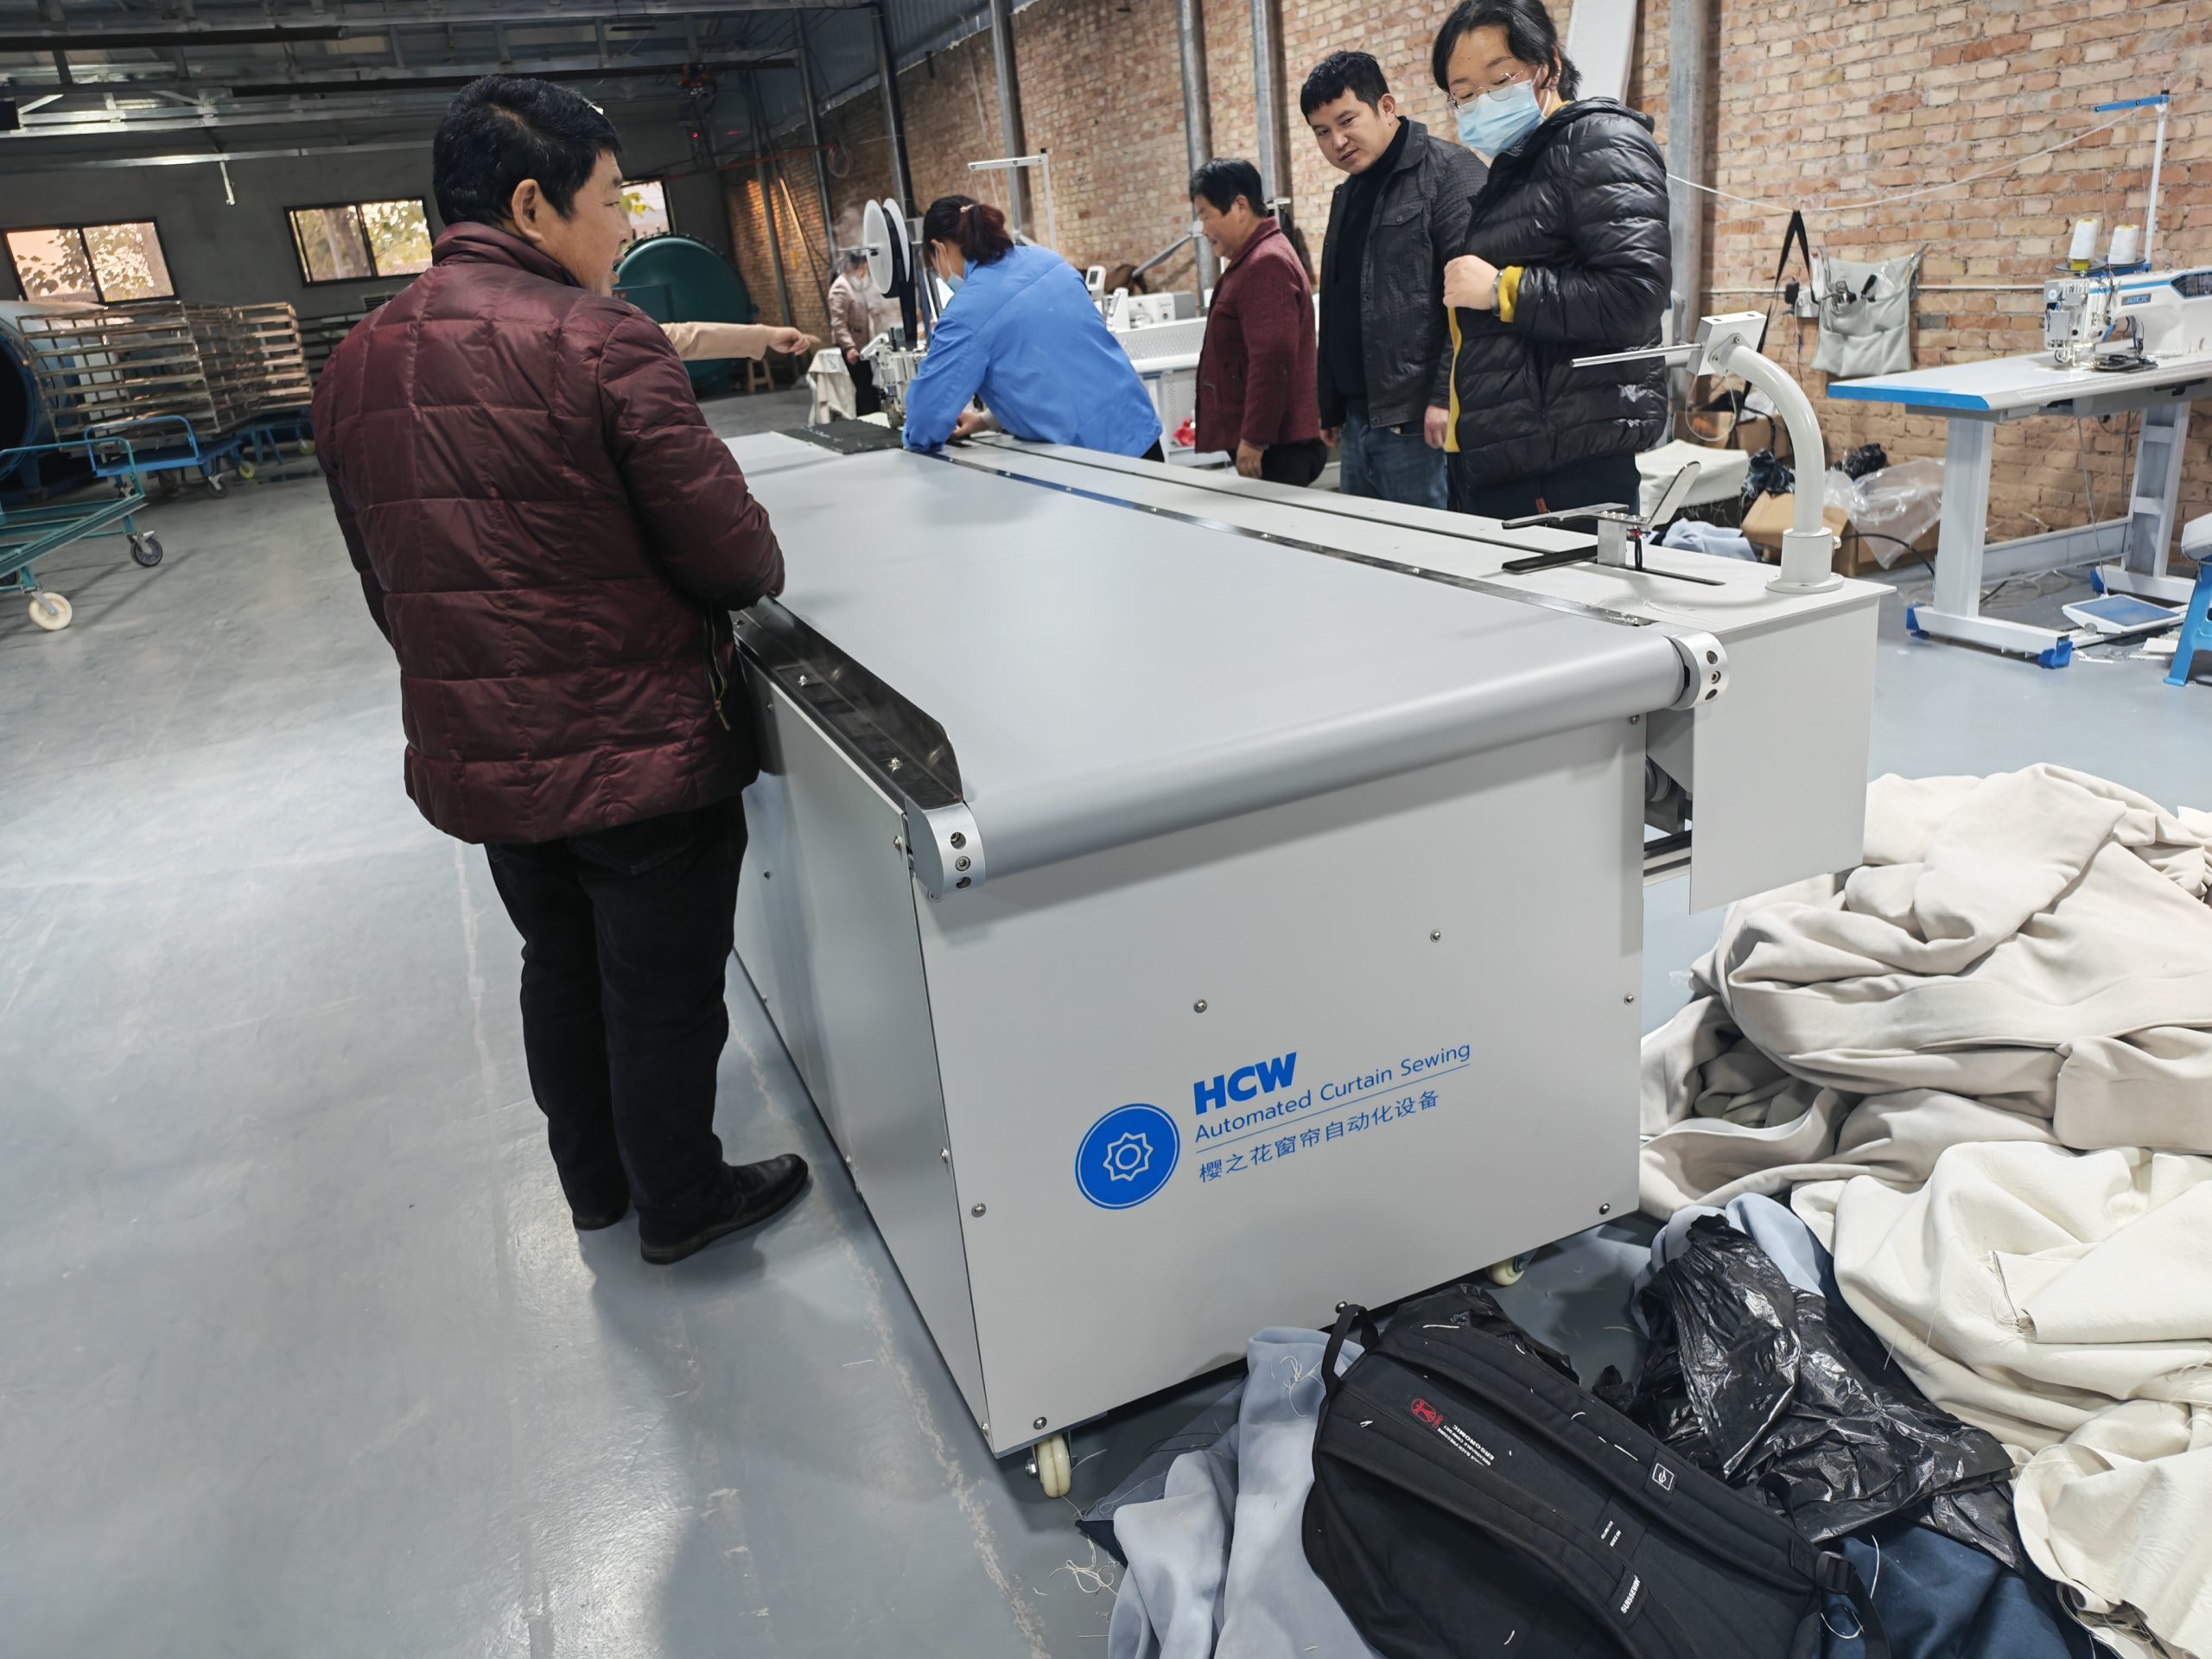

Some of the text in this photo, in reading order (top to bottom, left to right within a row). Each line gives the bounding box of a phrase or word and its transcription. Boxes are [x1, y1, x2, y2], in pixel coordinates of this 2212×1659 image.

[1193, 1052, 1297, 1115] HCW
[1195, 1044, 1471, 1142] Automated Curtain Sewing
[1200, 1090, 1439, 1183] 樱之花窗帘自动化设备
[1452, 1424, 1495, 1461] ERGONOMIC
